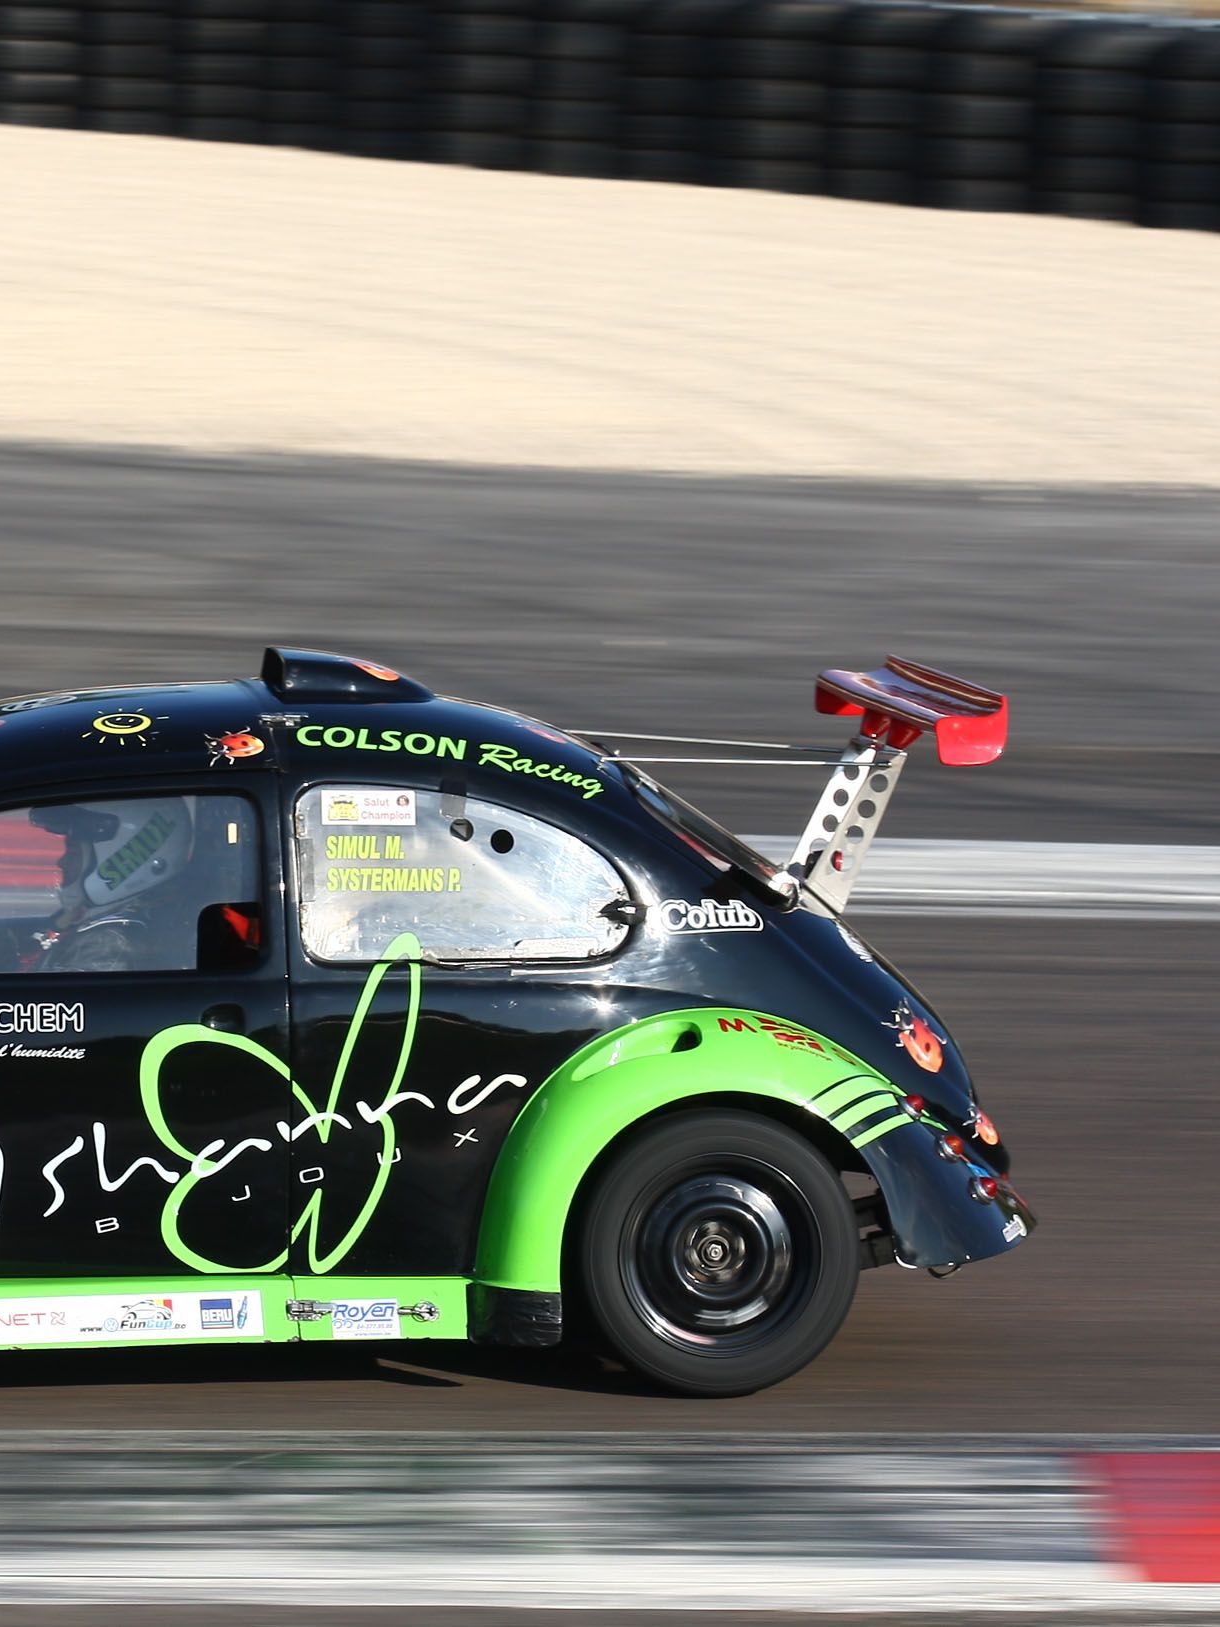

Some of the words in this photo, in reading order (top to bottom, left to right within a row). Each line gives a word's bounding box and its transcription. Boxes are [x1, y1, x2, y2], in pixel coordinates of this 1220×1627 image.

[296, 725, 468, 760] COLSON
[478, 743, 605, 799] Racing
[363, 797, 390, 807] Salut
[360, 810, 412, 822] Champion
[325, 834, 381, 860] SIMUL
[384, 834, 405, 860] M.
[326, 866, 445, 893] SYSTERMANS
[447, 866, 462, 893] P.
[661, 899, 759, 931] Colub
[202, 1308, 233, 1323] BERU
[333, 1302, 397, 1322] Royen
